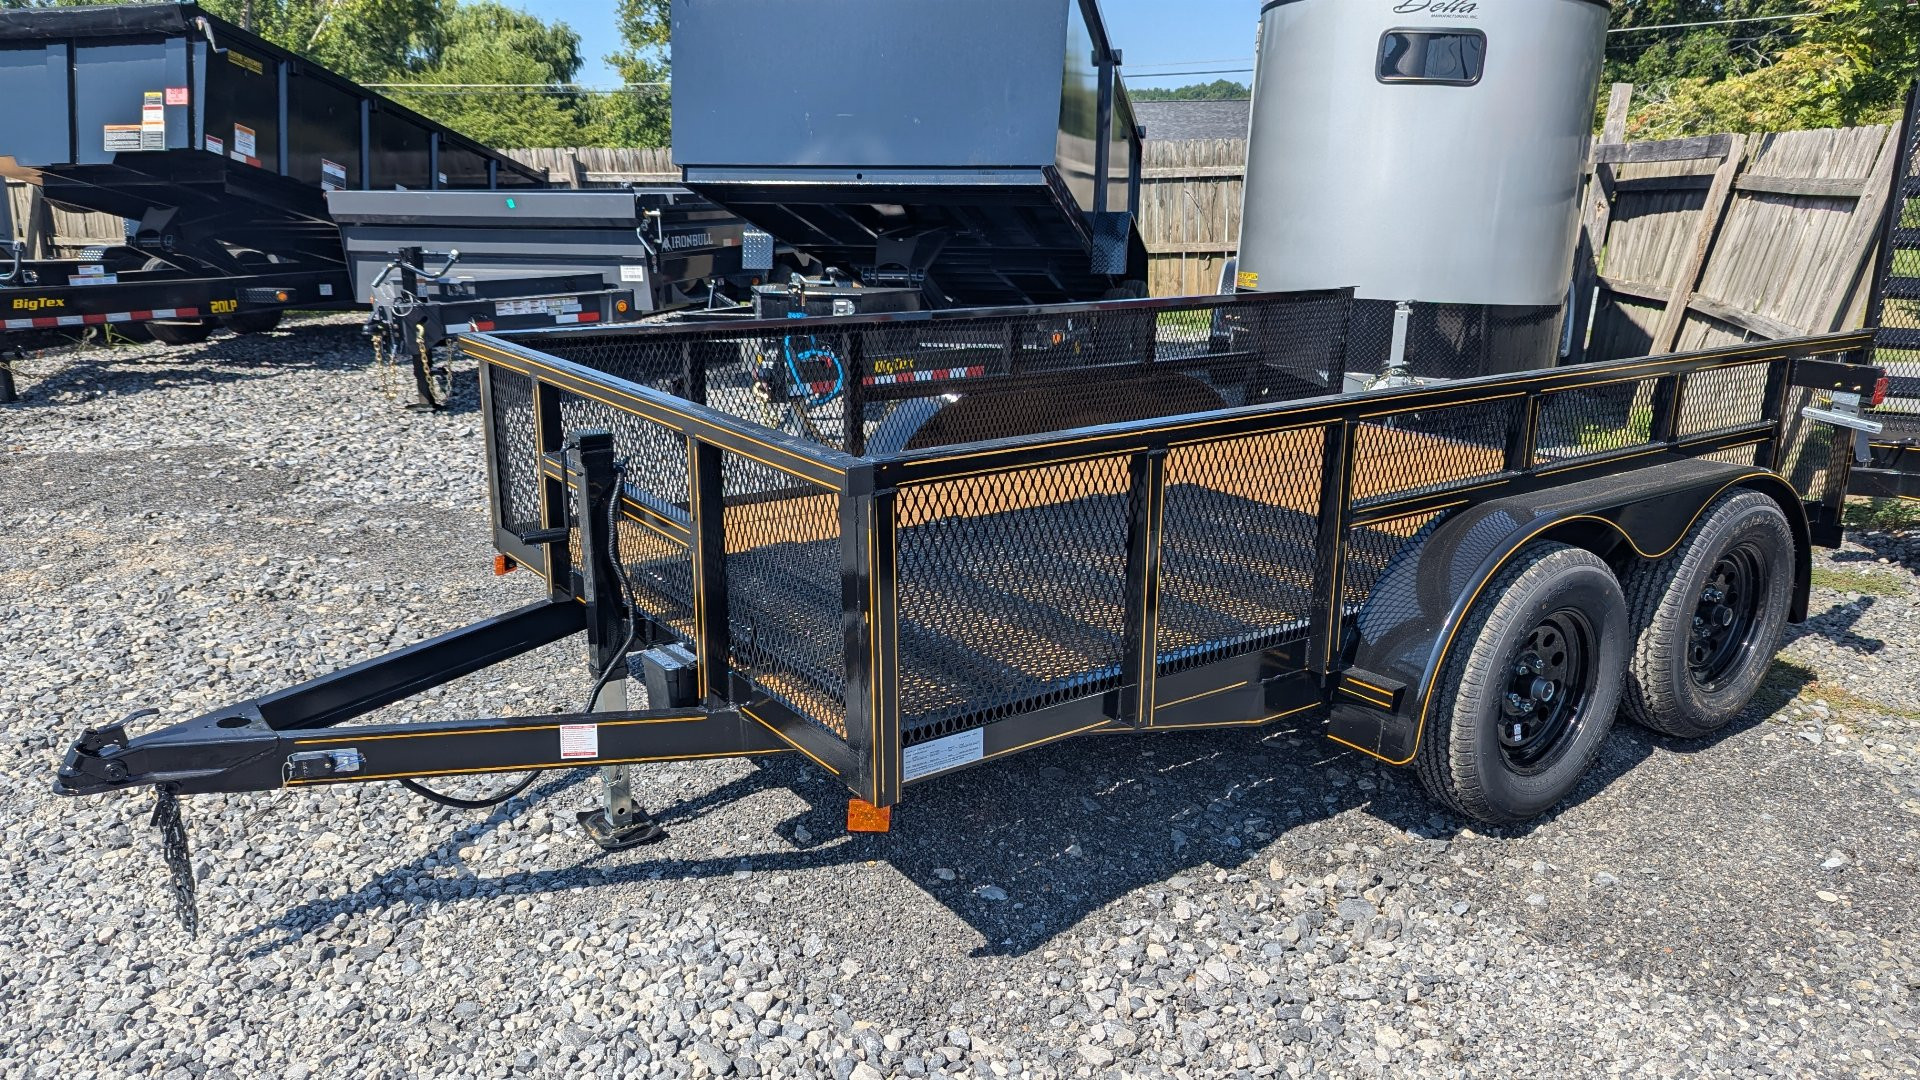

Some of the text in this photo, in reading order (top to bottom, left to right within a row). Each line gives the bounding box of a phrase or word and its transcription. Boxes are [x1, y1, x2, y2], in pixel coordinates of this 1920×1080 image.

[671, 232, 713, 249] IRONBULL
[13, 297, 65, 310] BigTex
[210, 300, 238, 313] 20LP
